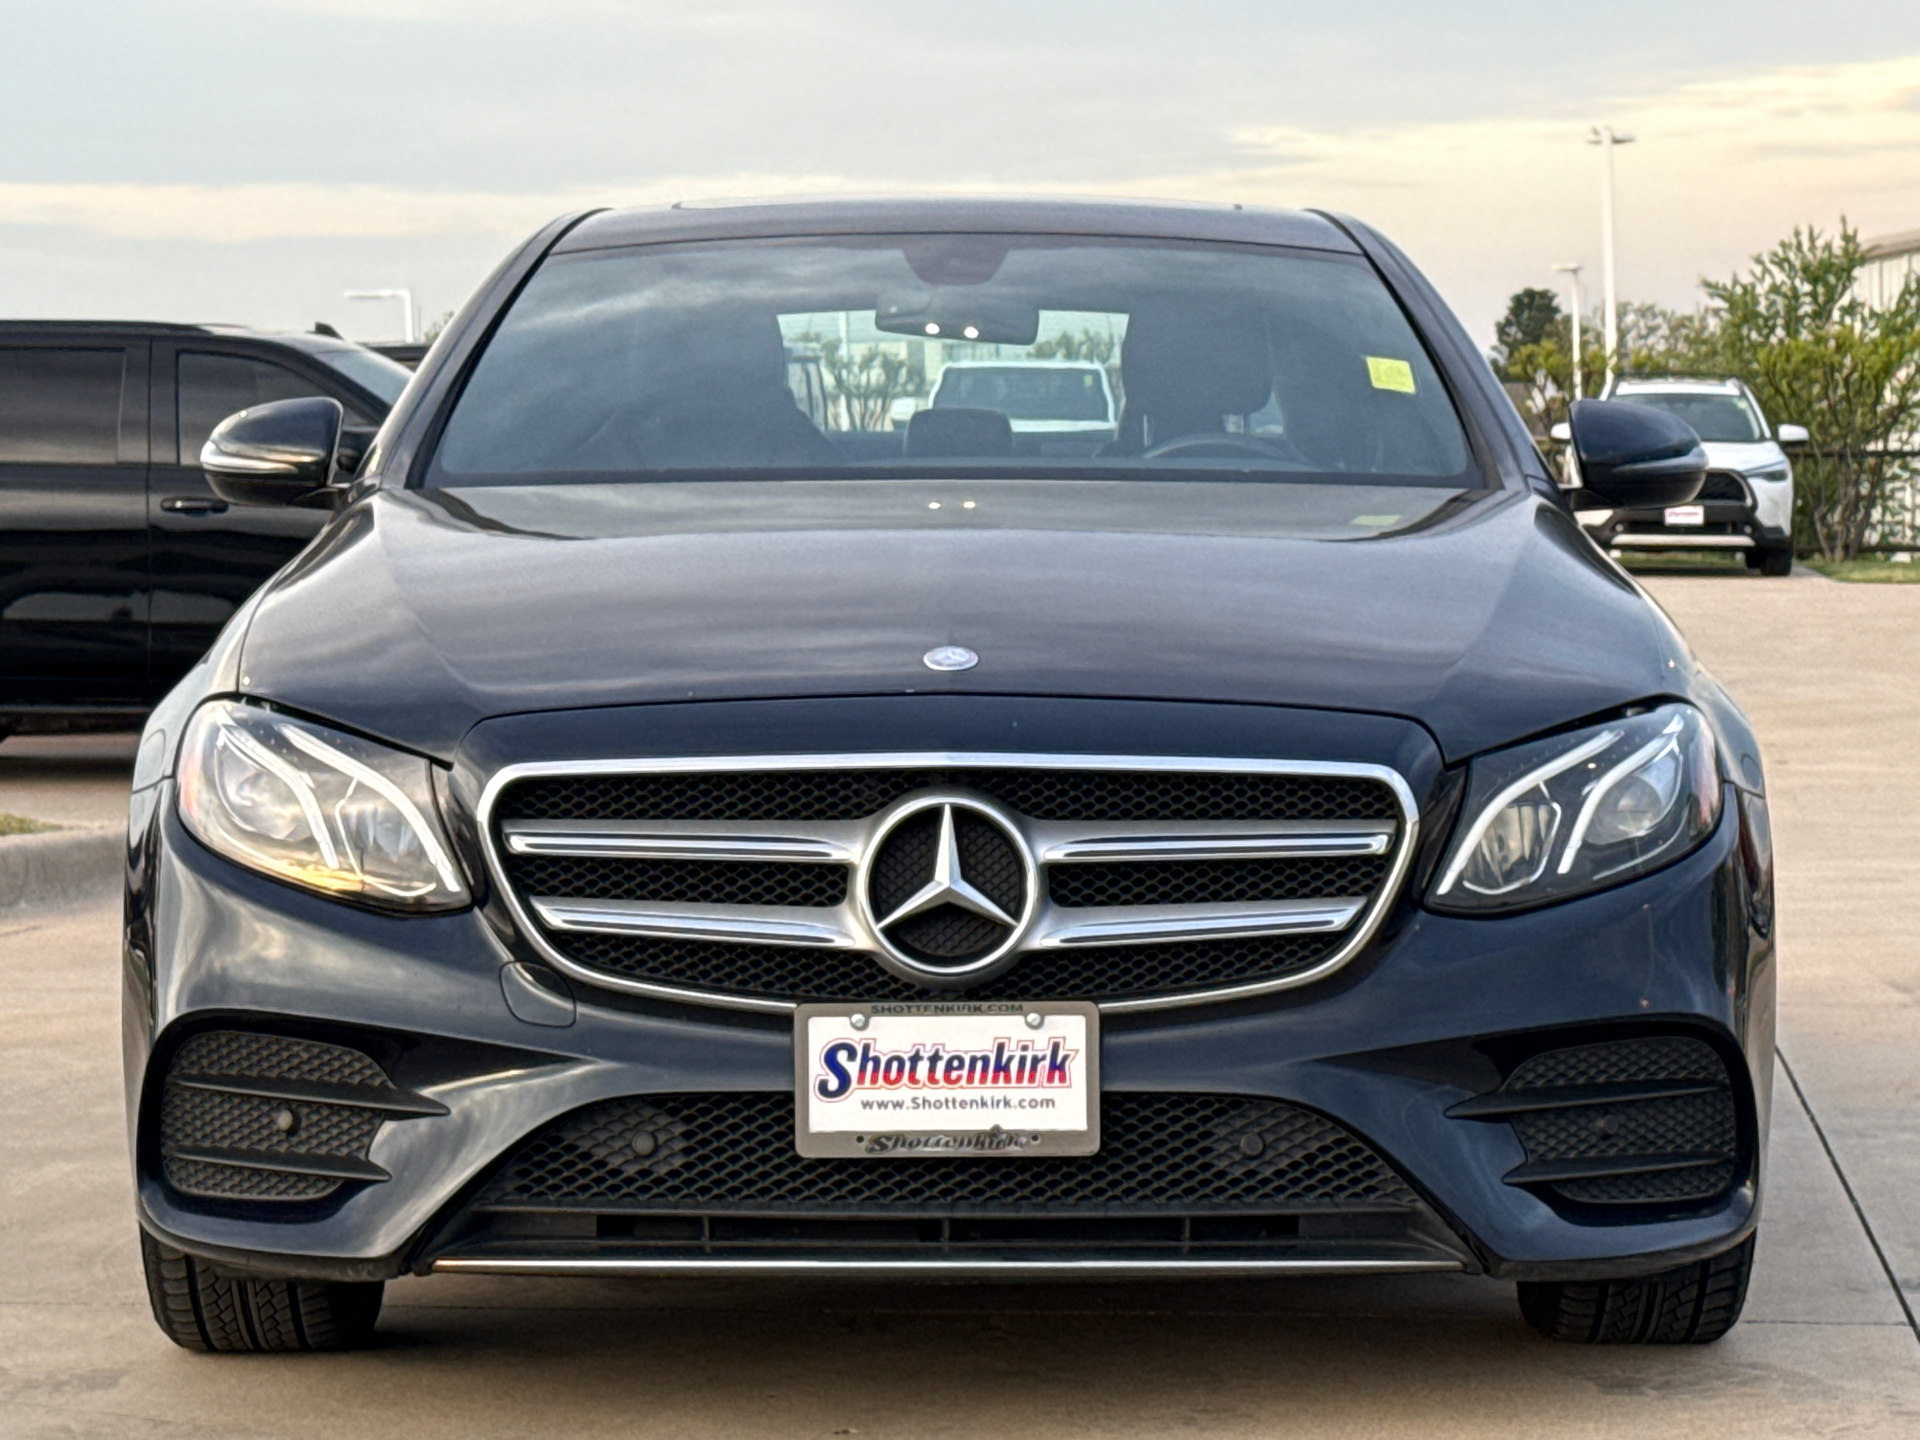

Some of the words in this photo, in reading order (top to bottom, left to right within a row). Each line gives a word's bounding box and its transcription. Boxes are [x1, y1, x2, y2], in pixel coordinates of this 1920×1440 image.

[870, 1003, 1024, 1014] SHOTTENKIRK.COM
[817, 1040, 1072, 1100] Shottenkirk
[861, 1095, 1056, 1111] www.Shottenkirk.com
